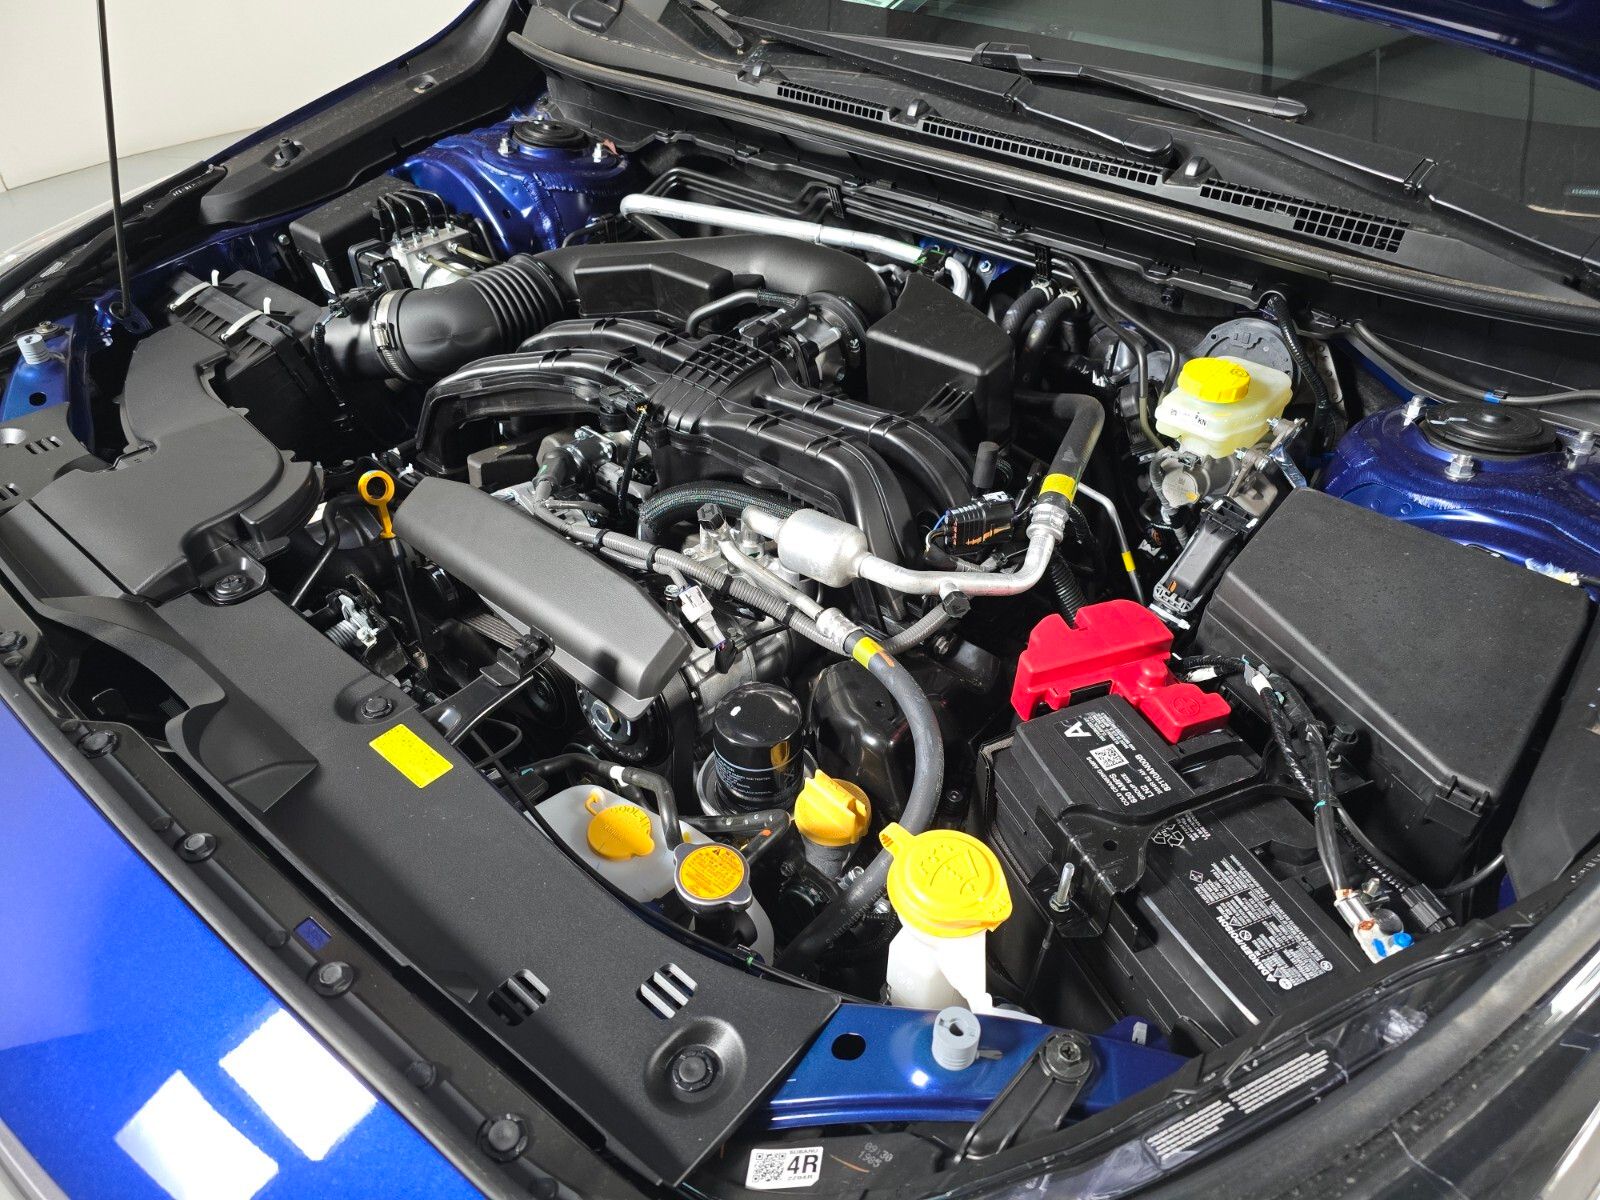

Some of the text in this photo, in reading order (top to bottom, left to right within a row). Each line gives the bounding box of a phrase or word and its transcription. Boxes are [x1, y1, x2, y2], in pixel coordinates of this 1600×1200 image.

[1063, 721, 1092, 738] A
[1086, 756, 1100, 769] AMPS
[1096, 769, 1119, 793] CRANKING
[1109, 773, 1128, 792] AMPS
[1116, 792, 1130, 806] COLD
[1129, 783, 1146, 800] GROUP
[1139, 784, 1155, 798] LN2
[1216, 915, 1270, 976] DANGER/POISON
[787, 1154, 819, 1174] 4R
